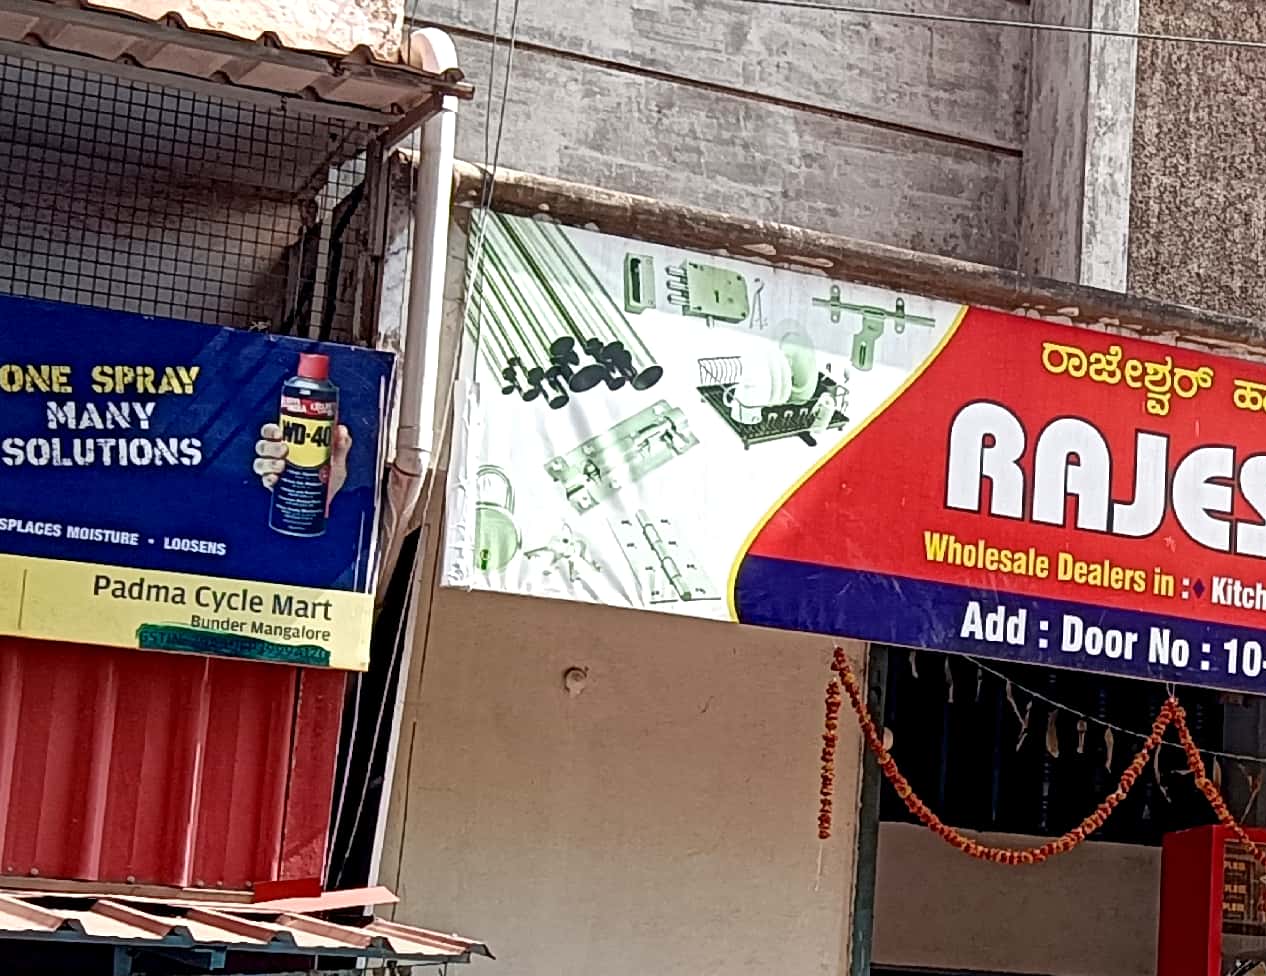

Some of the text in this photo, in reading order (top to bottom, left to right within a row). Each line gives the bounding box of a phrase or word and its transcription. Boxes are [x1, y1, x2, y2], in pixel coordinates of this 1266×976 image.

[0, 364, 200, 394] ONE SPRAY
[47, 401, 156, 429] MANY
[282, 420, 332, 448] WD-40
[1, 437, 203, 466] SOLUTIONS
[67, 525, 139, 545] MOISTURE
[164, 537, 227, 555] LOOSENS
[924, 530, 1050, 579] Wholesale
[1057, 551, 1146, 594] Dealers
[1153, 565, 1175, 598] in
[93, 574, 333, 622] Padma Cycle Mart
[191, 615, 331, 641] Bunder Mangalore
[961, 600, 1028, 648] Add
[1061, 615, 1137, 661] Door
[1148, 628, 1189, 668] No
